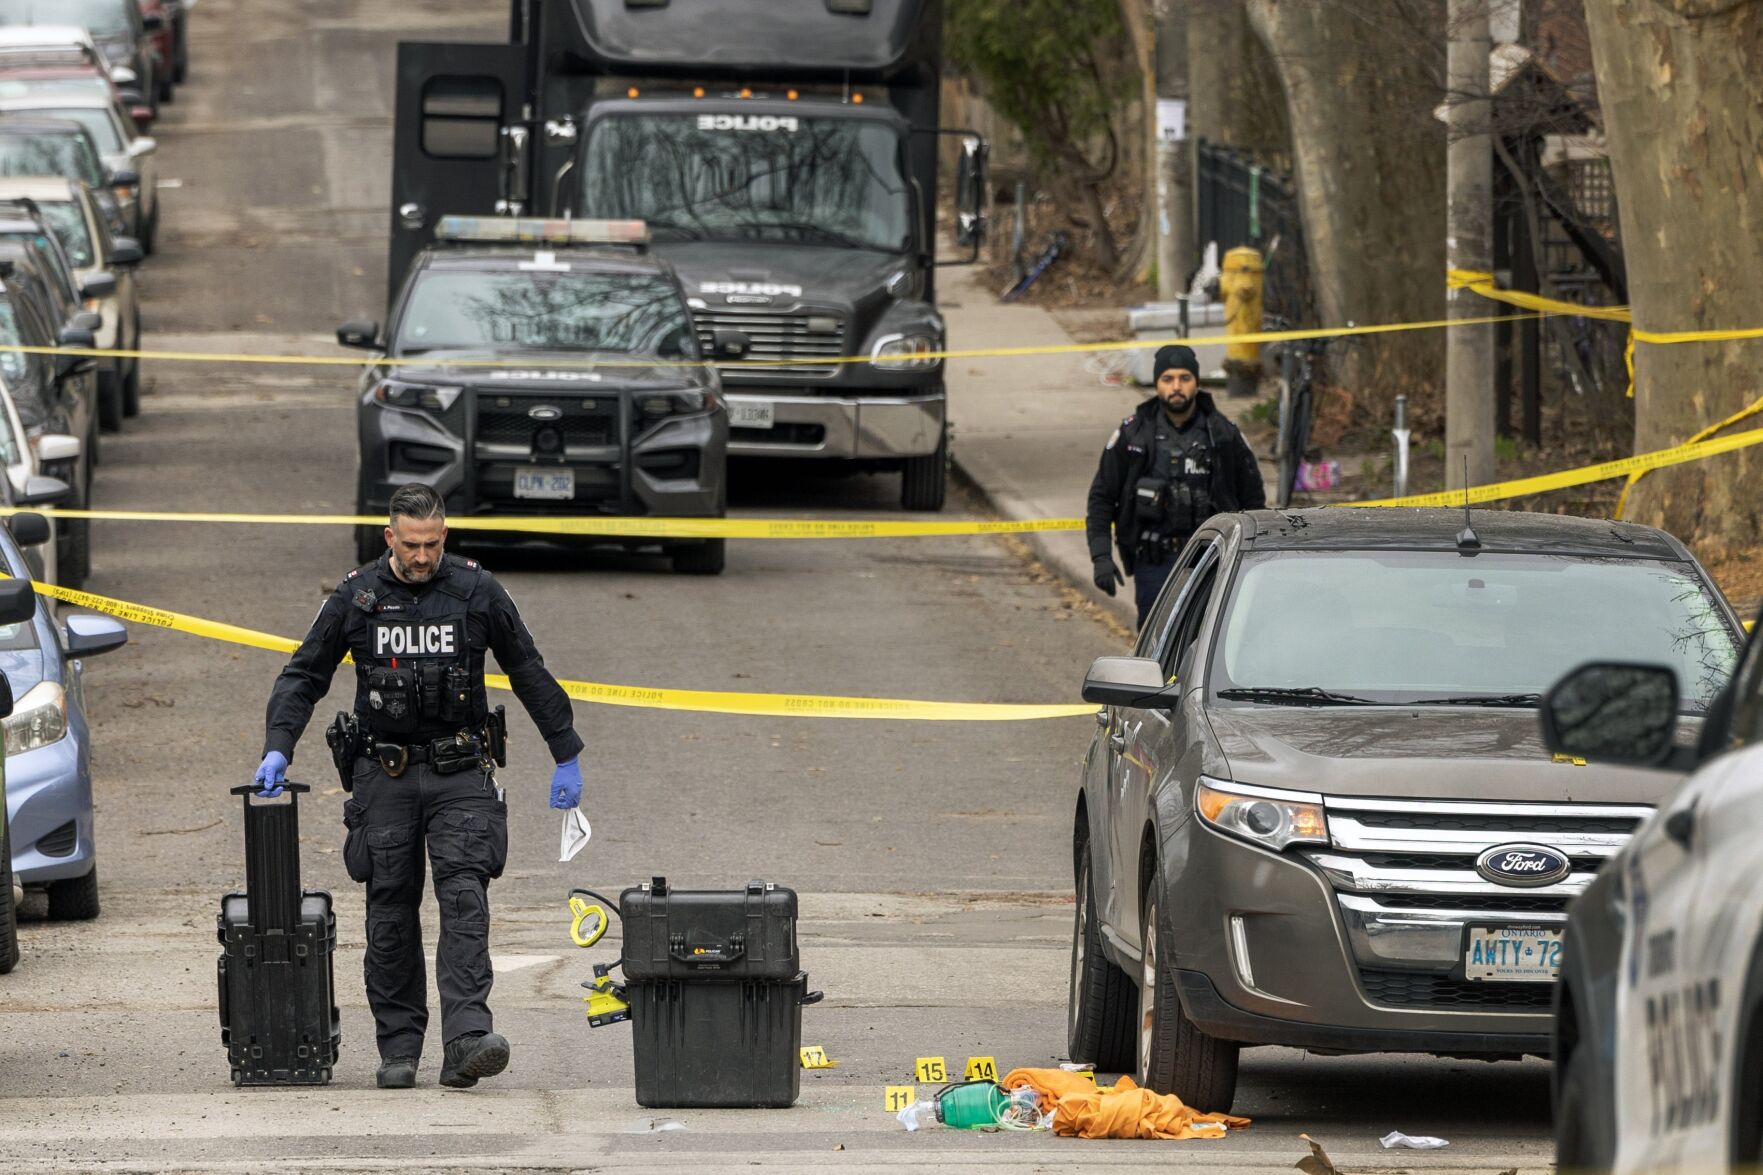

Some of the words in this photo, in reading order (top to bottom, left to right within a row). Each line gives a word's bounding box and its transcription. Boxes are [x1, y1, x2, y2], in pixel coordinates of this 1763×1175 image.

[119, 610, 138, 621] LINE
[125, 604, 155, 617] Stoppers
[156, 611, 175, 621] Crime
[142, 616, 173, 627] POLICE
[377, 625, 454, 654] POLICE
[1501, 852, 1546, 871] Ford
[1501, 929, 1546, 938] ONTARIO
[1471, 939, 1523, 966] AWTY
[803, 1052, 822, 1066] 17
[921, 1063, 943, 1081] 15
[974, 1062, 994, 1079] 14
[890, 1092, 908, 1110] 11
